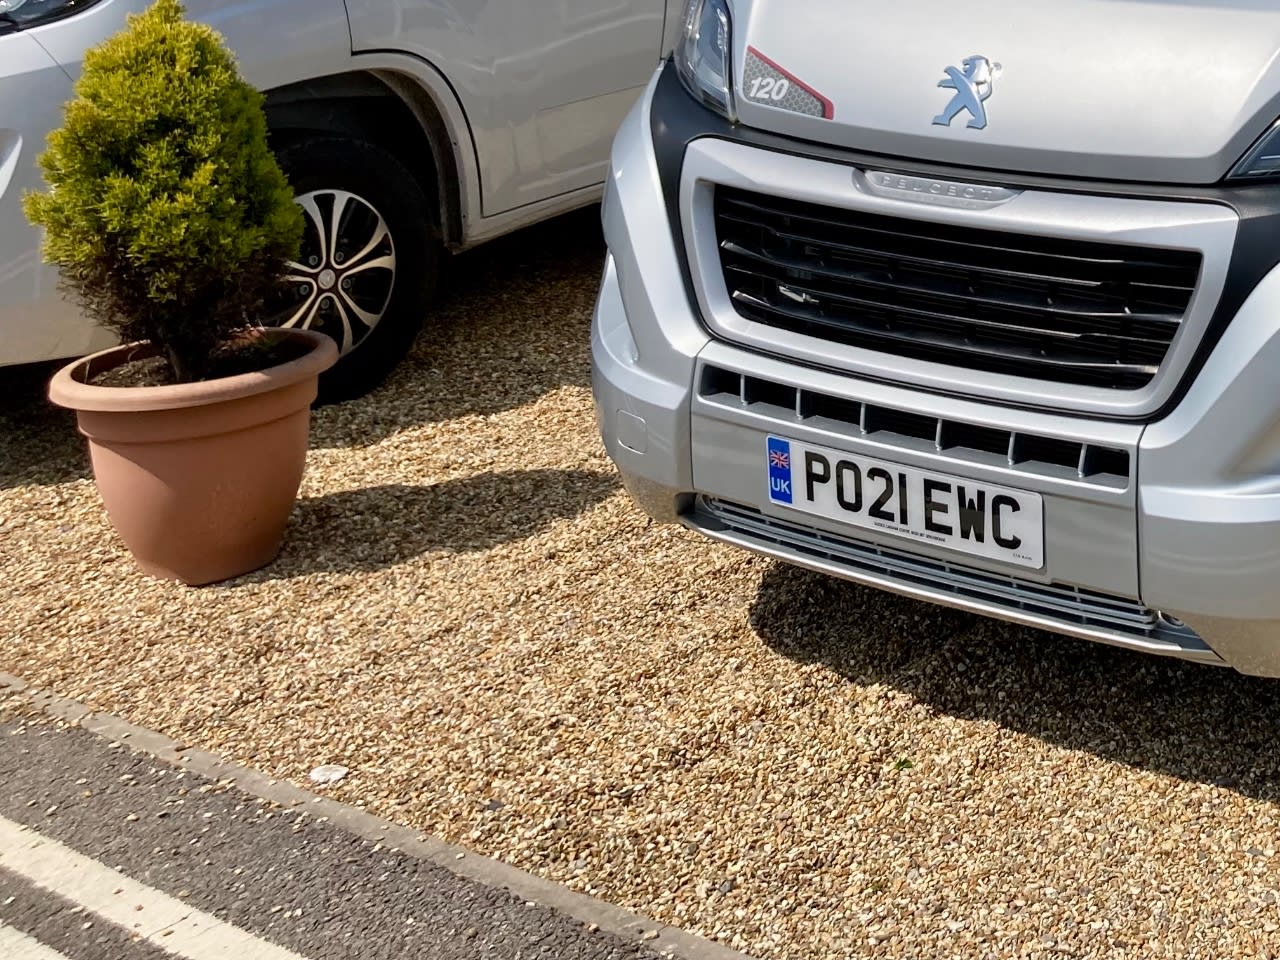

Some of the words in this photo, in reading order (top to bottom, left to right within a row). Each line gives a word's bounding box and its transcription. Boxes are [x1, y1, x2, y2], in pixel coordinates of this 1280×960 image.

[749, 76, 789, 100] 120
[771, 476, 791, 495] UK
[923, 478, 1022, 550] EWC
